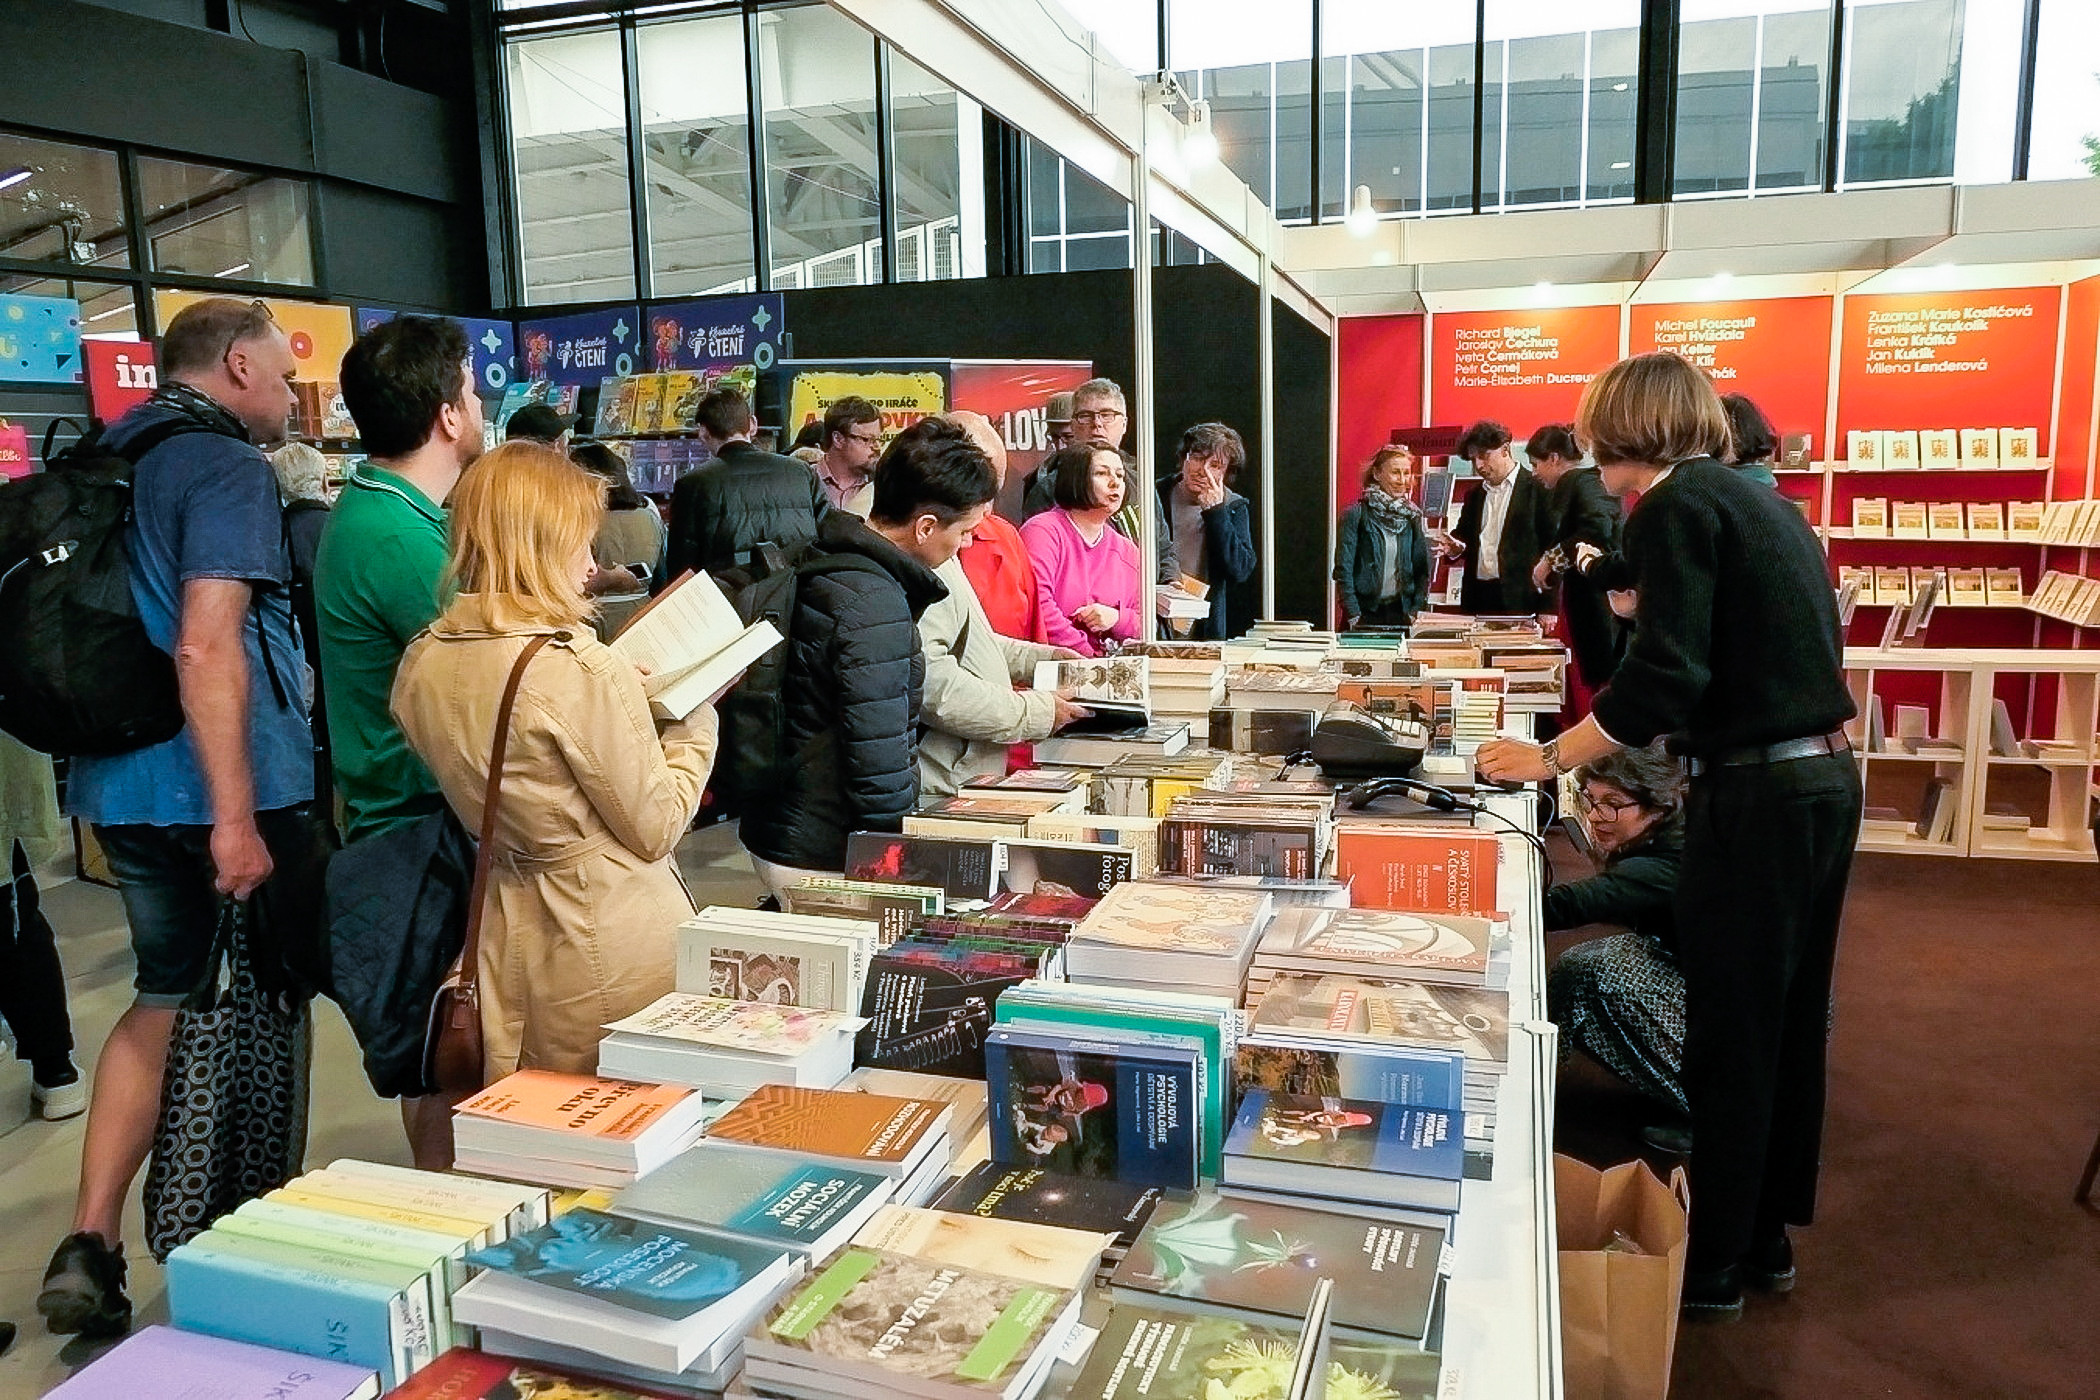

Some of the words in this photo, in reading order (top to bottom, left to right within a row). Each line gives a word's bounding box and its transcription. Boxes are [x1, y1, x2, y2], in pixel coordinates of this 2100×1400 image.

[1655, 319, 1698, 331] Michel
[1700, 317, 1756, 330] Foucault
[1868, 311, 1919, 323] Zuzana
[1920, 308, 1960, 321] Marie
[1455, 328, 1500, 340] Richard
[1868, 321, 1927, 335] František
[1929, 319, 1989, 332] Koukolík
[709, 335, 744, 357] ČTENÍ
[1455, 340, 1503, 351] Jaroslav
[1655, 331, 1687, 343] Karel
[1867, 336, 1909, 348] Lenka
[575, 346, 606, 368] ČTENÍ
[1455, 353, 1484, 363] Iveta
[1487, 348, 1559, 361] Čermáková
[1680, 343, 1717, 355] Keller
[1866, 349, 1892, 361] Jan
[1455, 364, 1478, 374] Petr
[1866, 363, 1911, 374] Milena
[1914, 358, 1988, 373] Lenderová
[1116, 856, 1129, 882] Pos
[1460, 849, 1470, 879] SVATÝ
[556, 1087, 600, 1112] oku
[1156, 1074, 1168, 1144] PSYCHOLOGIE
[1167, 1075, 1180, 1129] VÝVOJOVÁ
[765, 1180, 818, 1218] MOZEK
[780, 1178, 845, 1228] SOCIÁLNÍ
[573, 1235, 671, 1286] POSEDLOST
[594, 1241, 689, 1289] MOCENSKÁ
[868, 1268, 959, 1360] METUZALÉM
